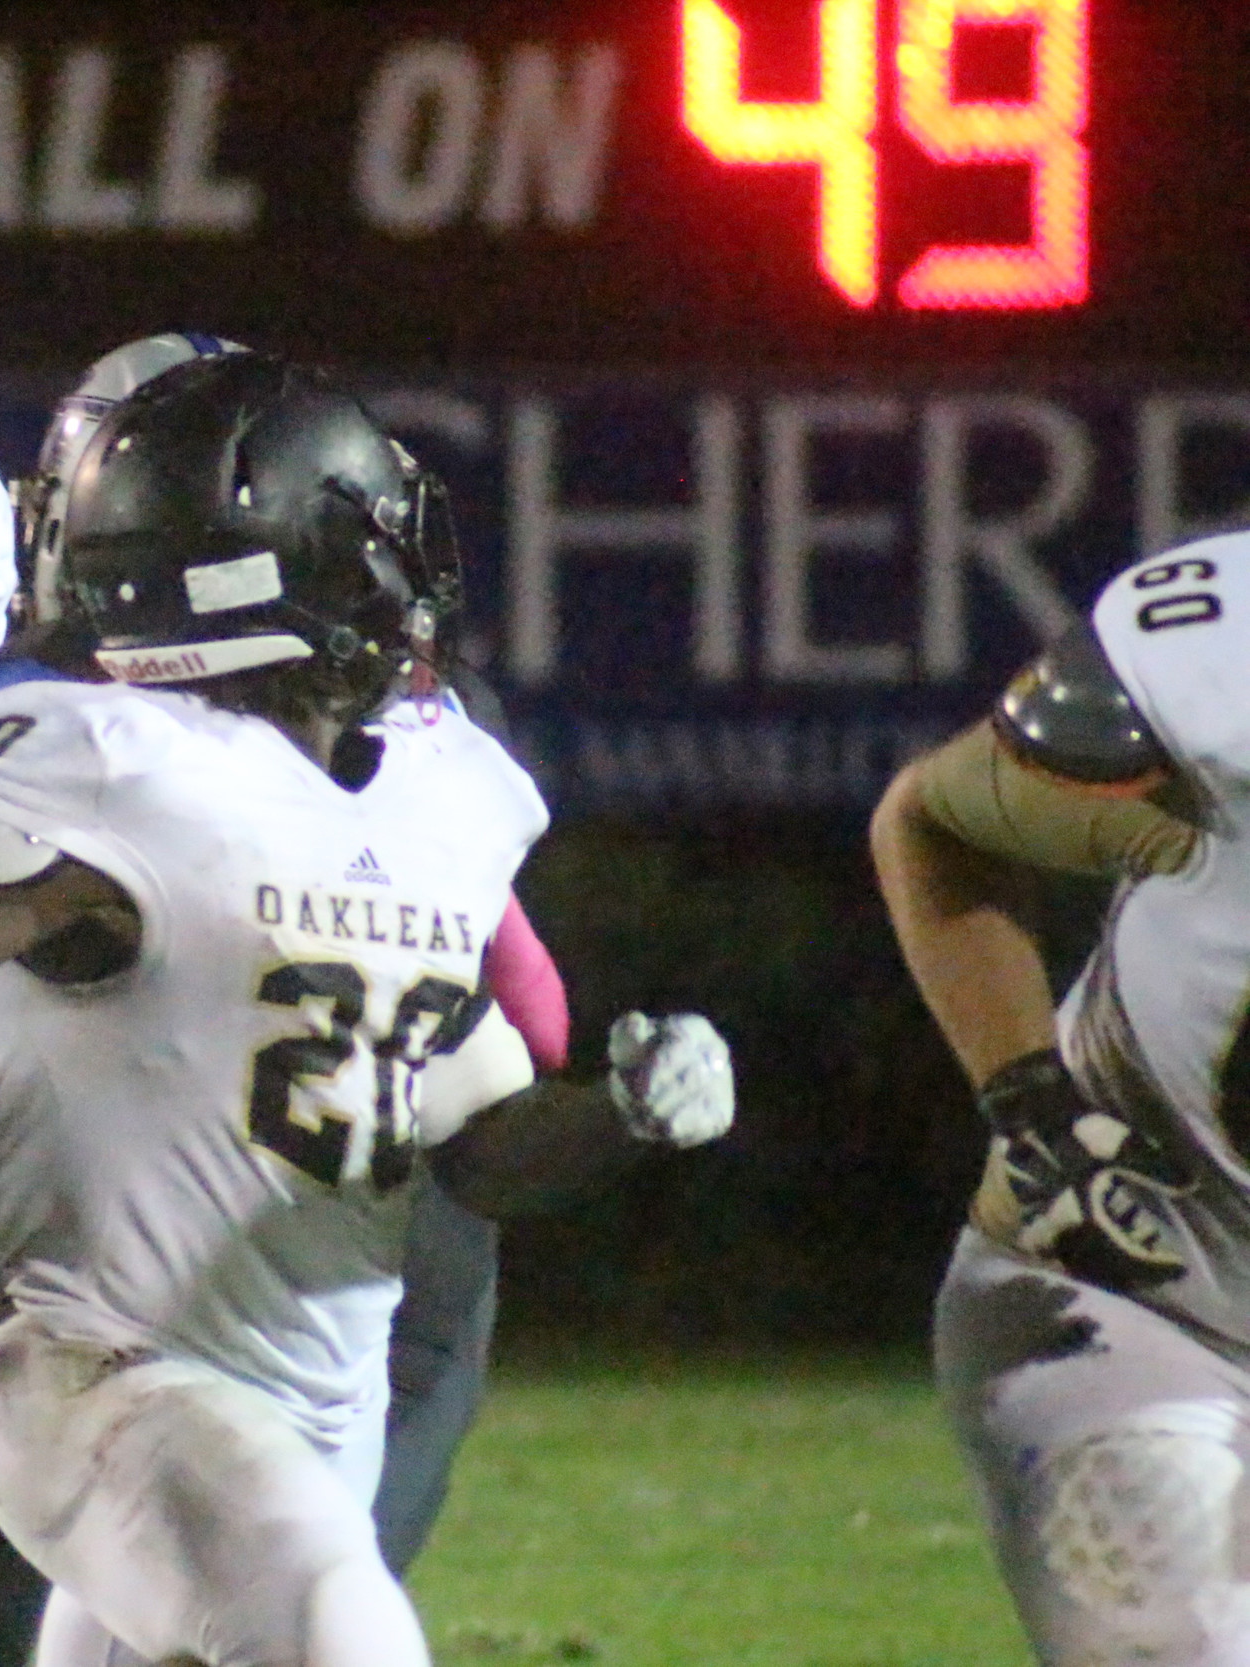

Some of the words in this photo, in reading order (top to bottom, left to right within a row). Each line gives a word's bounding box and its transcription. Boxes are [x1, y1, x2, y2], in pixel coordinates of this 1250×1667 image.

[358, 42, 622, 236] ON
[681, 0, 1092, 308] 49
[1134, 559, 1221, 632] 60
[256, 884, 474, 953] OAKLEAF
